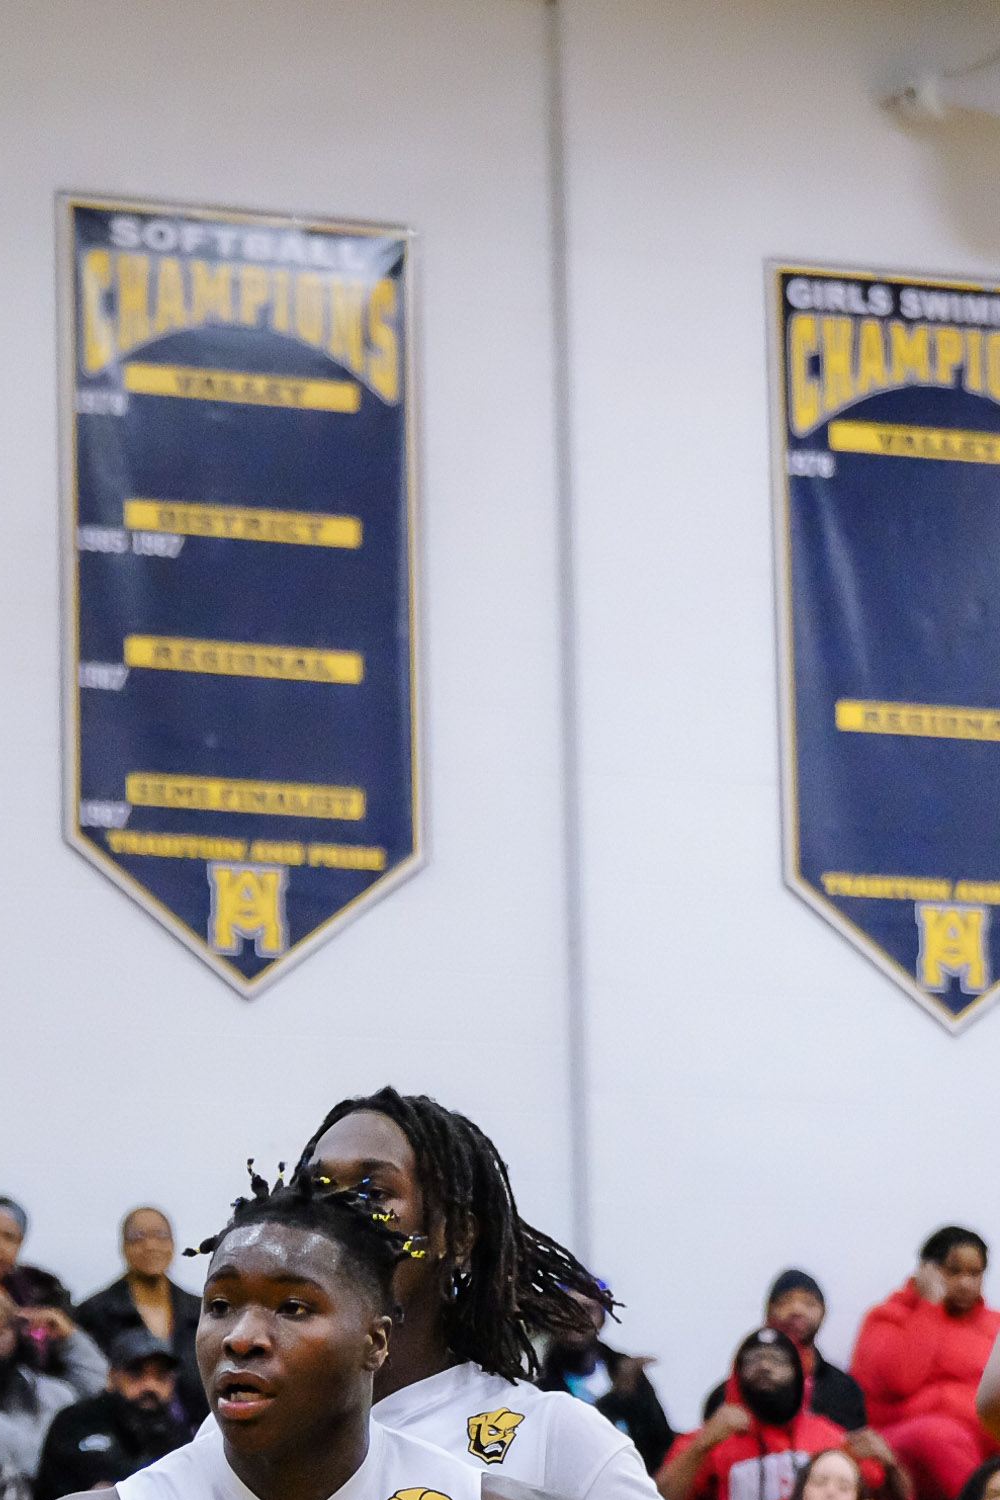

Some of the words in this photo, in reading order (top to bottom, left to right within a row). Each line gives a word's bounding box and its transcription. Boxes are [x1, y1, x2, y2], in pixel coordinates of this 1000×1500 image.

[786, 277, 893, 317] GIRLS
[81, 247, 399, 406] CHAMPIONS
[153, 644, 331, 679] REGIONAL
